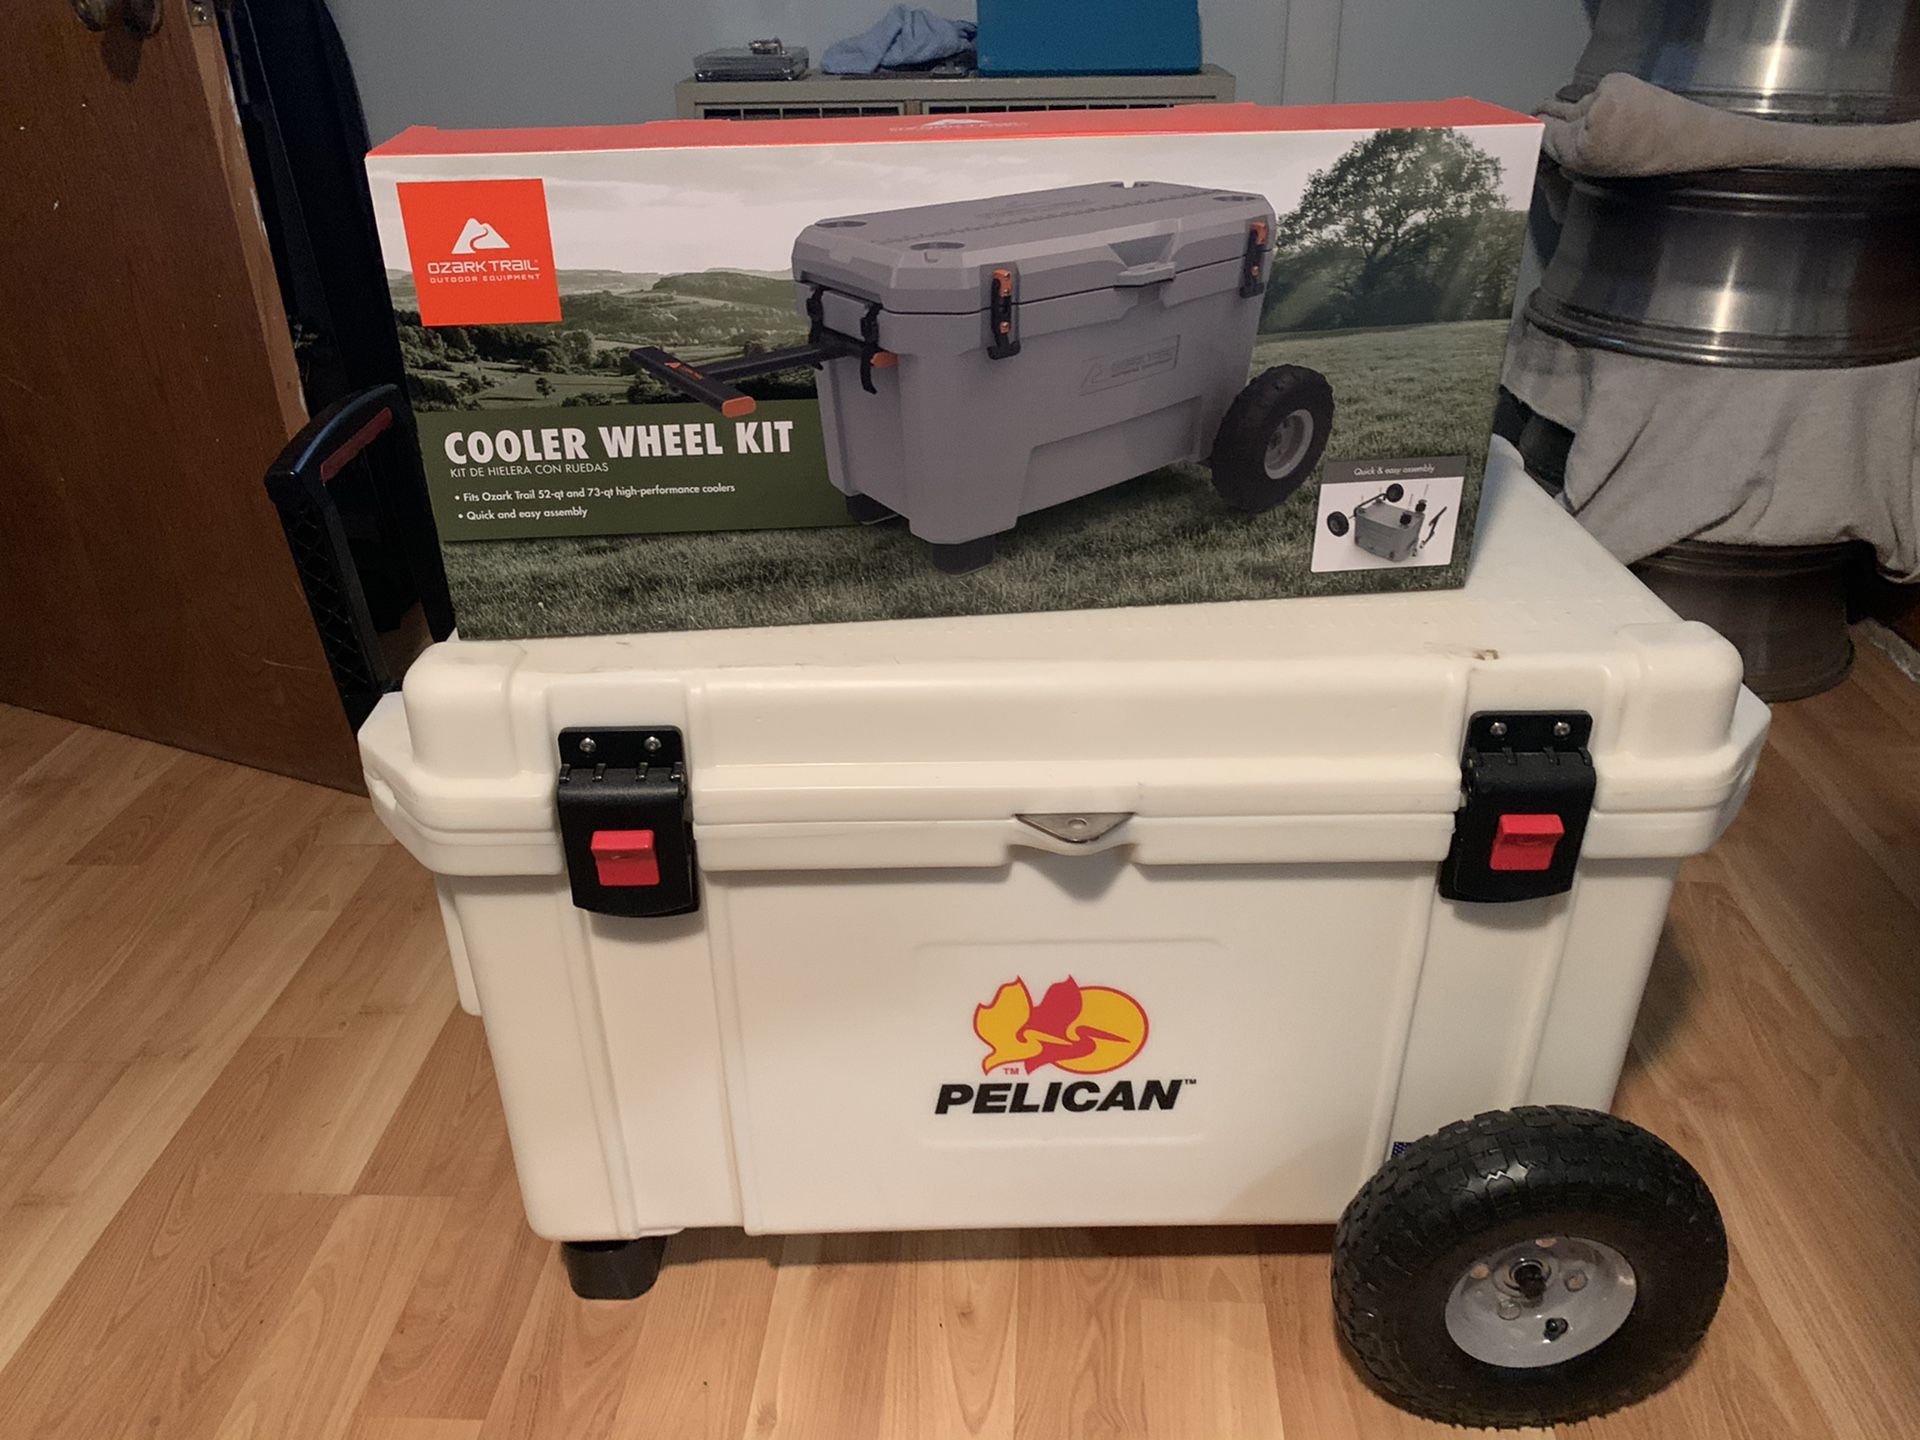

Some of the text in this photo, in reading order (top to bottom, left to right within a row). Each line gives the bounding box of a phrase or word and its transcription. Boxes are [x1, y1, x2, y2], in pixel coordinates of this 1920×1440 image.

[427, 259, 540, 274] OZARK TRAIL
[430, 274, 541, 284] OUTDOOR EQUIPMENT
[444, 421, 794, 465] COOLER WHEEL KIT
[450, 462, 609, 478] KIT DE HIELERA CON RUEDAS
[1353, 466, 1376, 476] Quick
[1384, 467, 1402, 475] easy
[1403, 463, 1435, 474] assembly
[463, 482, 736, 502] Fits Ozark Trail 52-qt and 73-qt high-performance coolers
[466, 505, 588, 521] Quick and easy assembly
[934, 1079, 1183, 1115] PELICAN
